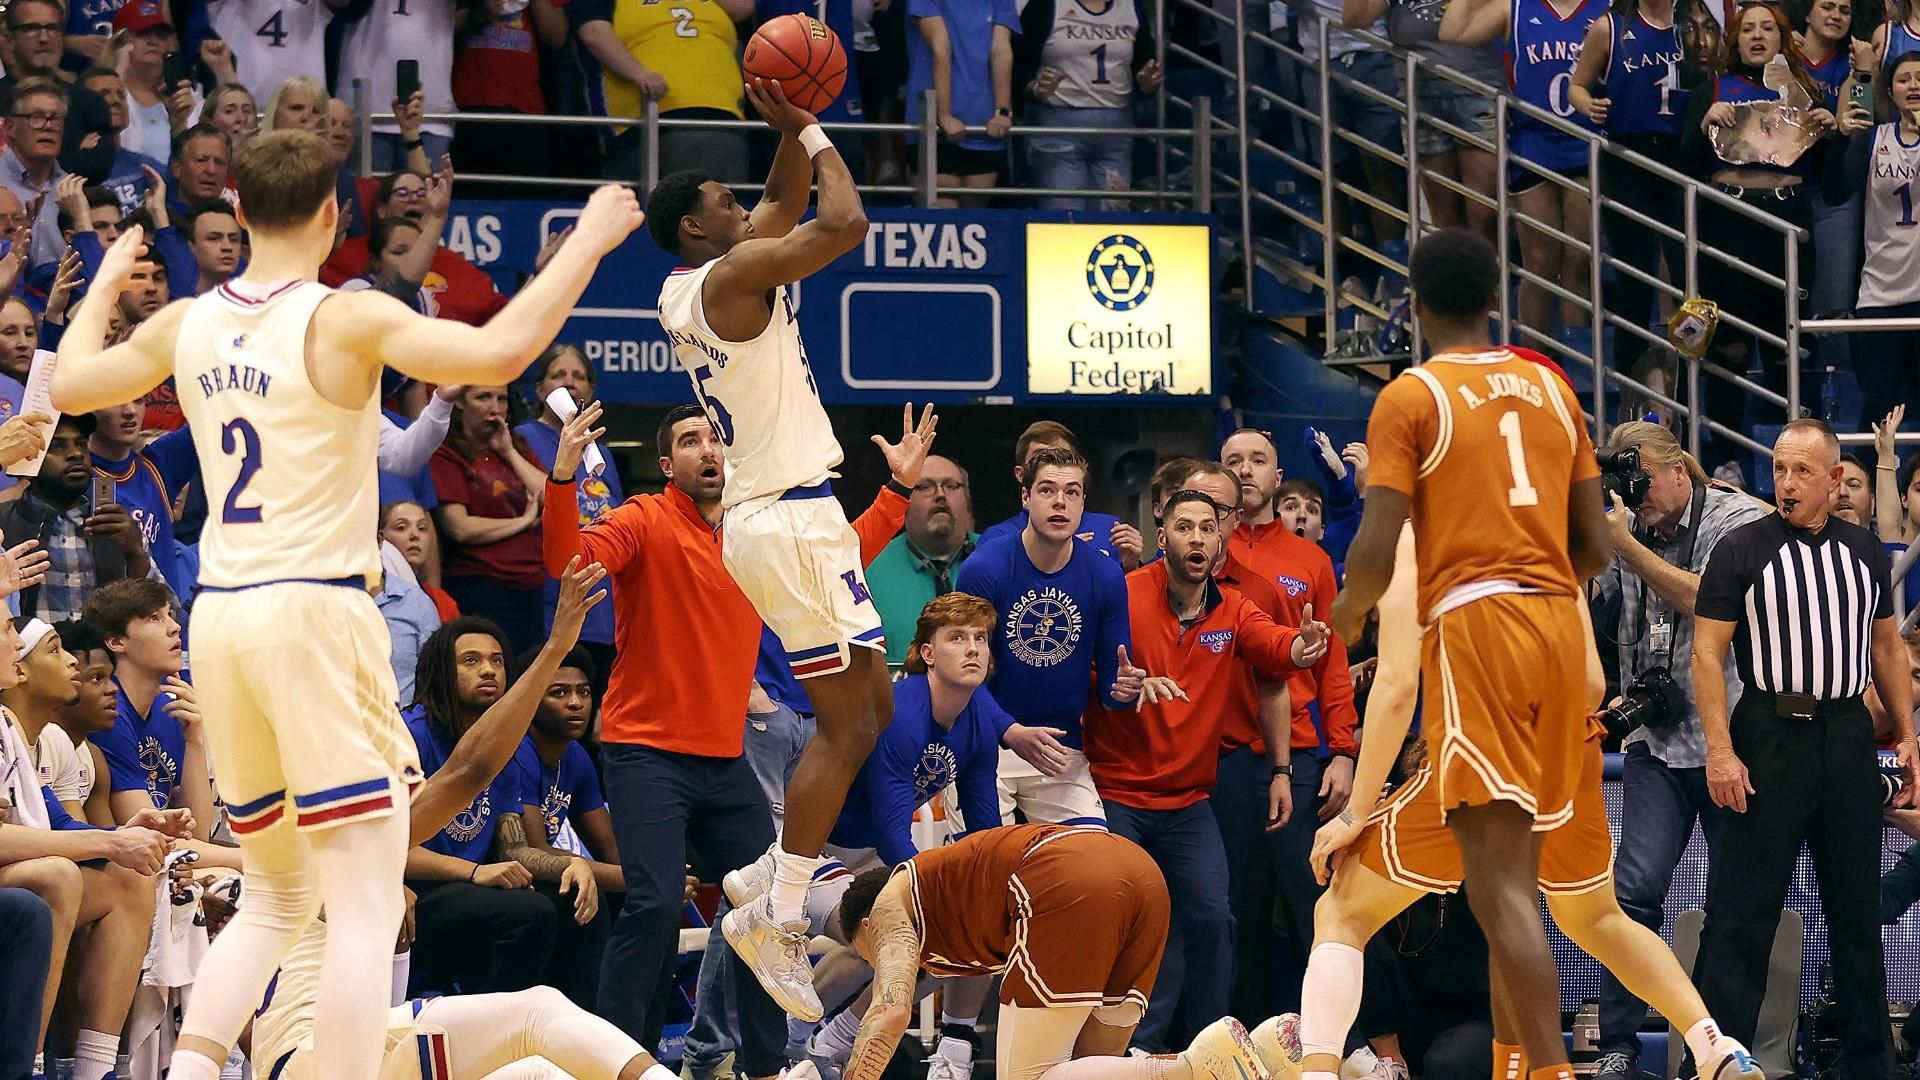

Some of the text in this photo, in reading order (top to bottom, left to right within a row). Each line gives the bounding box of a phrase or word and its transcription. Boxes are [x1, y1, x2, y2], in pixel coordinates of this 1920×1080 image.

[257, 9, 288, 48] 4
[670, 8, 699, 38] 2
[1066, 24, 1131, 40] KANSAS
[1090, 43, 1111, 85] 1
[1653, 74, 1675, 116] 1
[1893, 182, 1919, 227] 1
[864, 222, 988, 270] TEXAS
[1067, 321, 1174, 354] Capitol
[198, 364, 273, 400] BRAUN
[1069, 361, 1176, 389] Federal
[1485, 372, 1544, 409] JONES
[694, 363, 735, 447] 5
[222, 417, 264, 525] 2
[1498, 411, 1539, 507] 1
[1278, 575, 1308, 593] KANSAS
[1006, 586, 1083, 643] KANSAS JAYHAWKS
[1008, 639, 1076, 667] BASKETBALL
[1200, 631, 1233, 643] KANSAS
